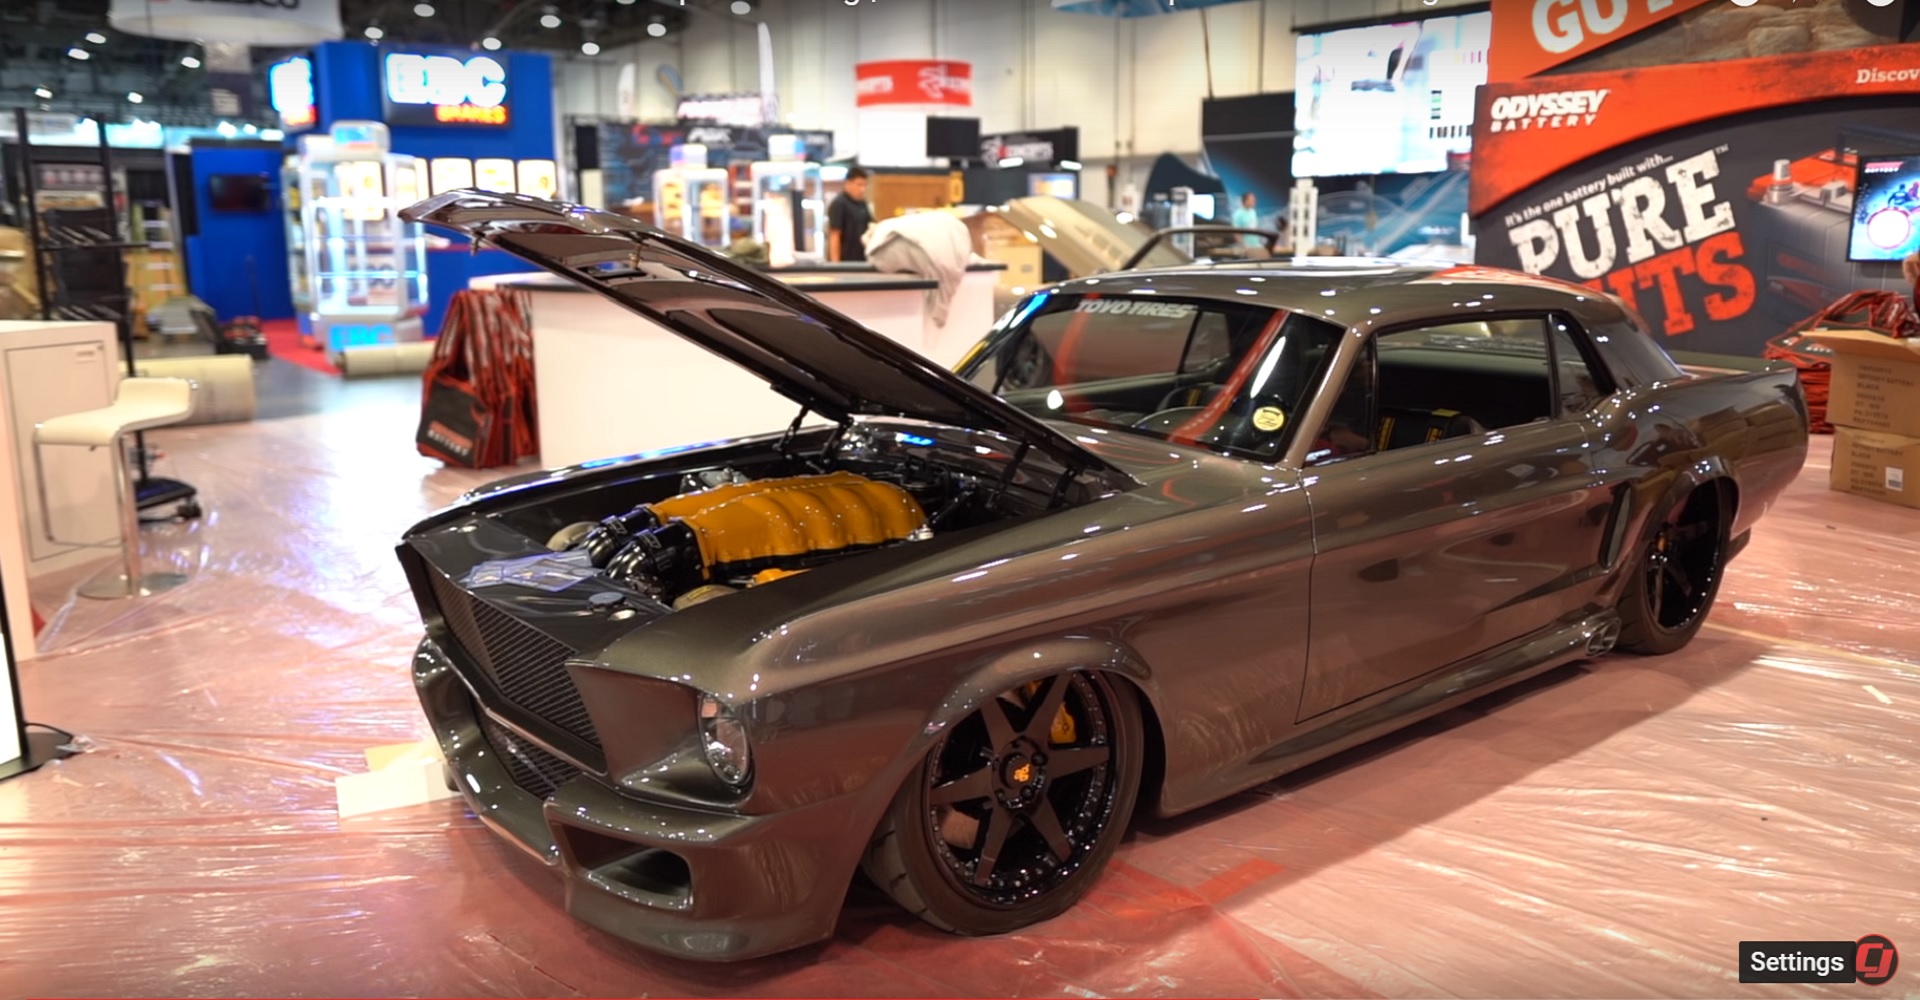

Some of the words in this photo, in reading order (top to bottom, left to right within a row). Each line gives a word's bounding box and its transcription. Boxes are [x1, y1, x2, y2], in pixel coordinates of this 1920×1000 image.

[1491, 89, 1608, 120] ODYSSEY
[1490, 113, 1597, 133] BATTERY
[1504, 211, 1523, 228] It's
[1523, 203, 1543, 220] the
[1542, 197, 1564, 213] one
[1564, 178, 1607, 204] battery
[1606, 167, 1636, 187] built
[1508, 149, 1736, 280] PURE
[1075, 298, 1132, 315] TOYO
[1128, 301, 1199, 319] TIRES
